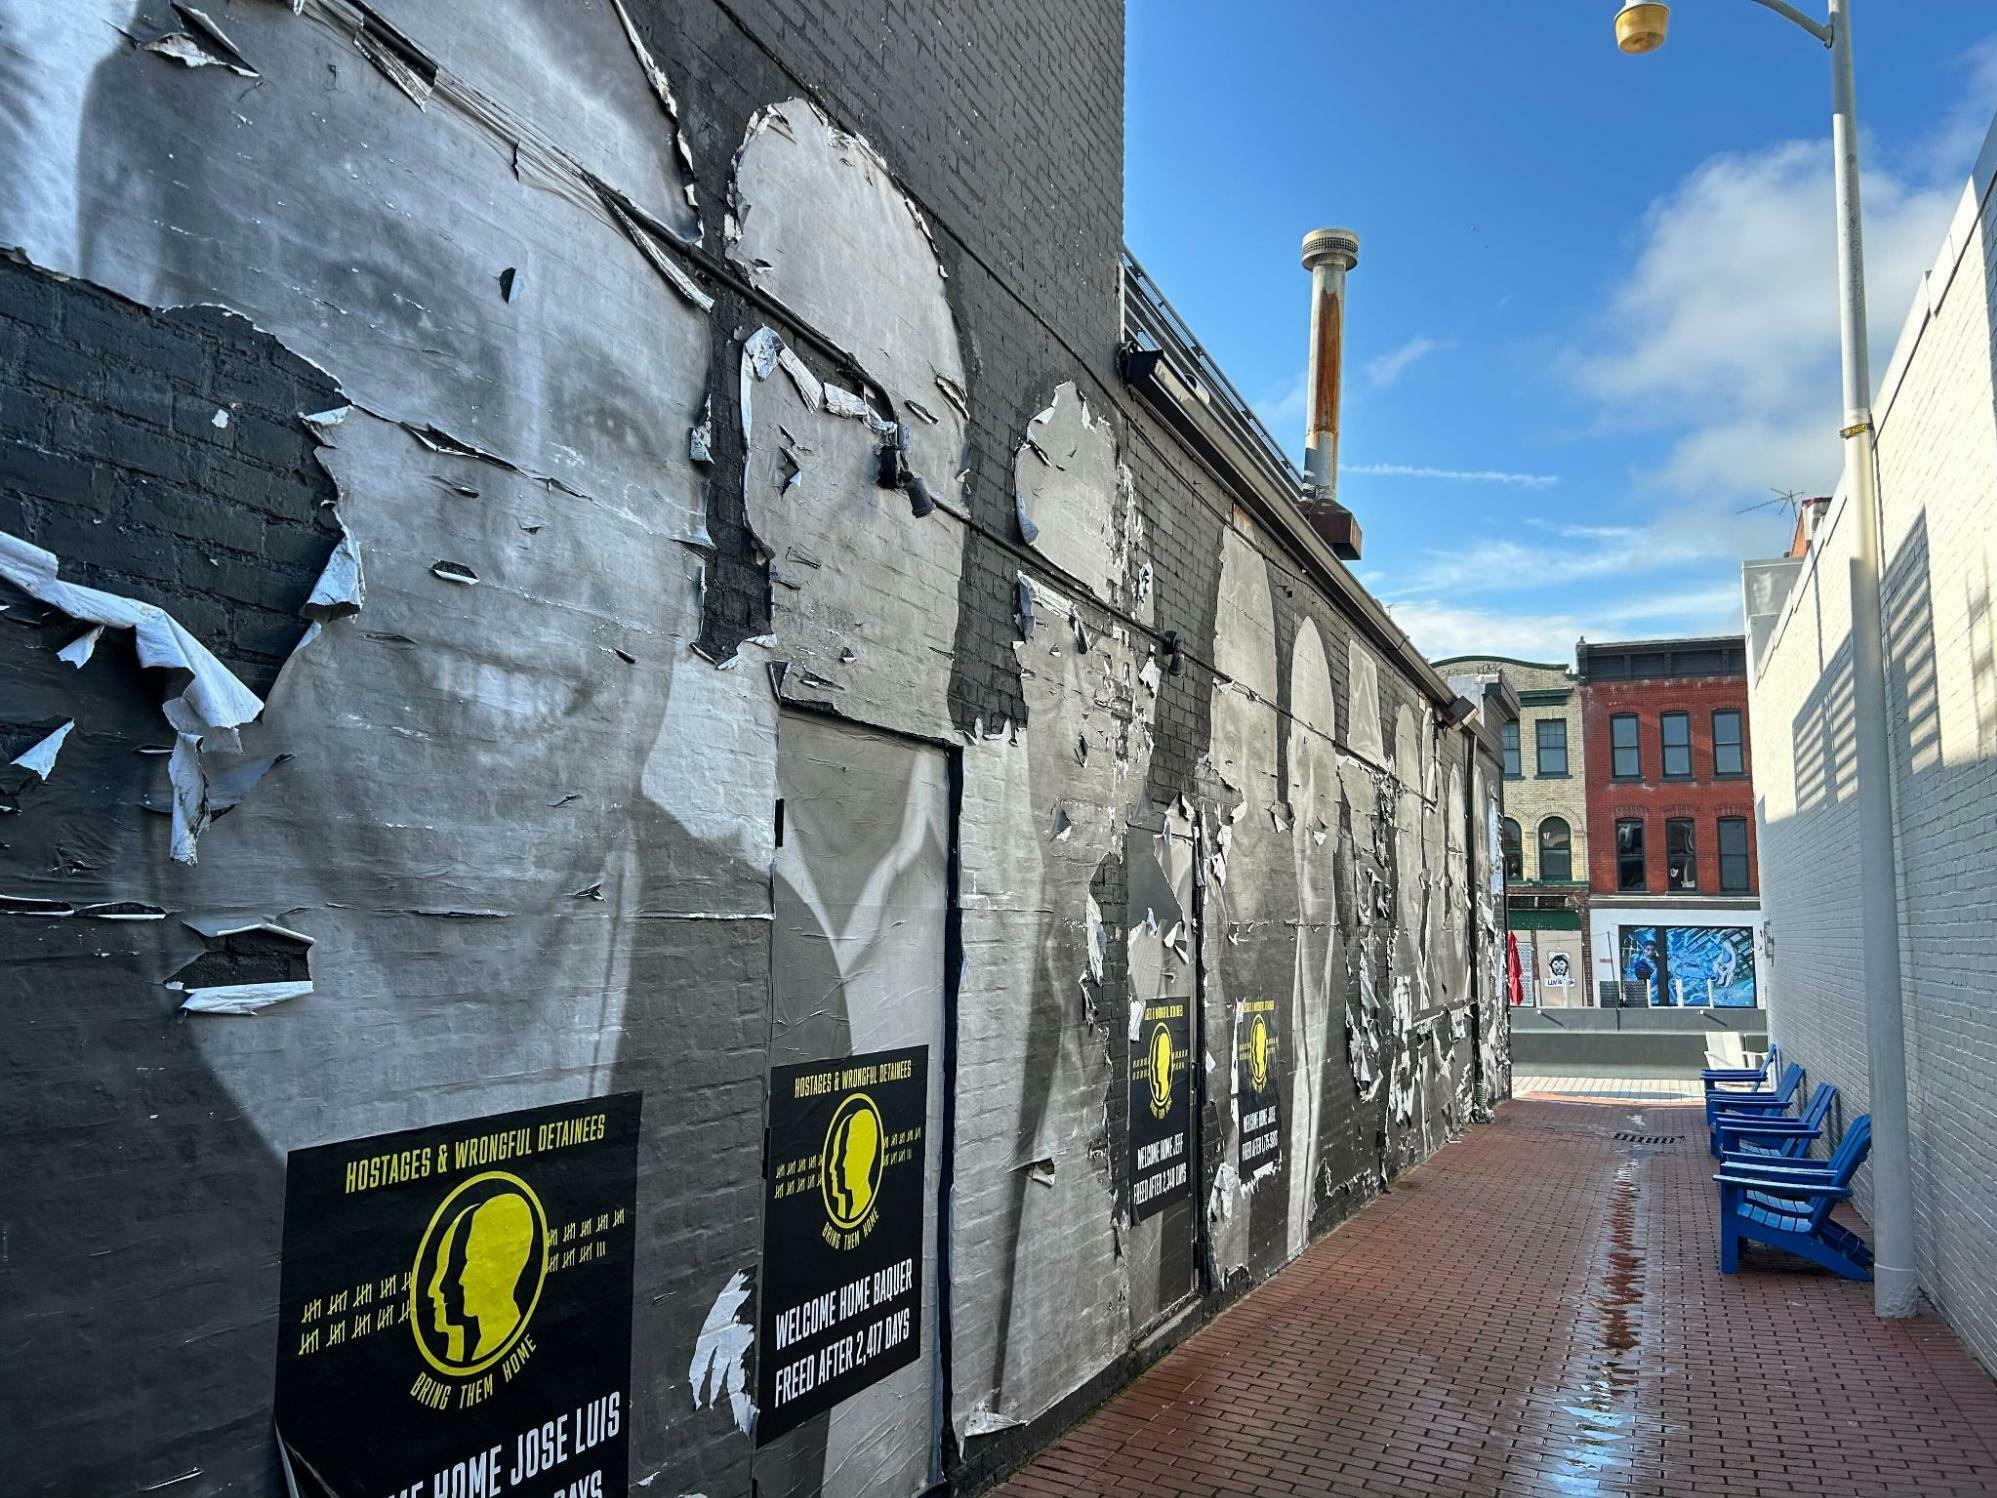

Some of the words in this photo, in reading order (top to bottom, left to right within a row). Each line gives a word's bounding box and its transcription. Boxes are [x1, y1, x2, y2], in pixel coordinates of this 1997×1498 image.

[794, 1072, 832, 1098] HOSTAGES
[834, 1071, 839, 1091] &
[842, 1065, 877, 1090] WRONGFUL
[879, 1060, 912, 1083] DETAINEES
[345, 1147, 431, 1193] HOSTAGES
[437, 1144, 448, 1173] &
[455, 1127, 531, 1170] WRONGFUL
[538, 1114, 606, 1152] DETAINEES
[822, 1221, 841, 1250] BRING
[844, 1230, 860, 1251] THEM
[862, 1206, 879, 1238] HOME
[776, 1290, 837, 1350] WELCOME
[839, 1275, 871, 1321] HOME
[873, 1258, 912, 1305] BAQUER
[410, 1371, 451, 1410] BRING
[459, 1373, 493, 1409] THEM
[502, 1333, 537, 1383] HOME
[775, 1354, 815, 1408] FREED
[818, 1335, 853, 1386] AFTER
[855, 1320, 883, 1366] 2,417
[885, 1307, 910, 1350] DAYS
[433, 1444, 502, 1498] HOME
[510, 1413, 568, 1486] JOSE
[575, 1391, 620, 1455] LUIS
[553, 1470, 602, 1498] YS
